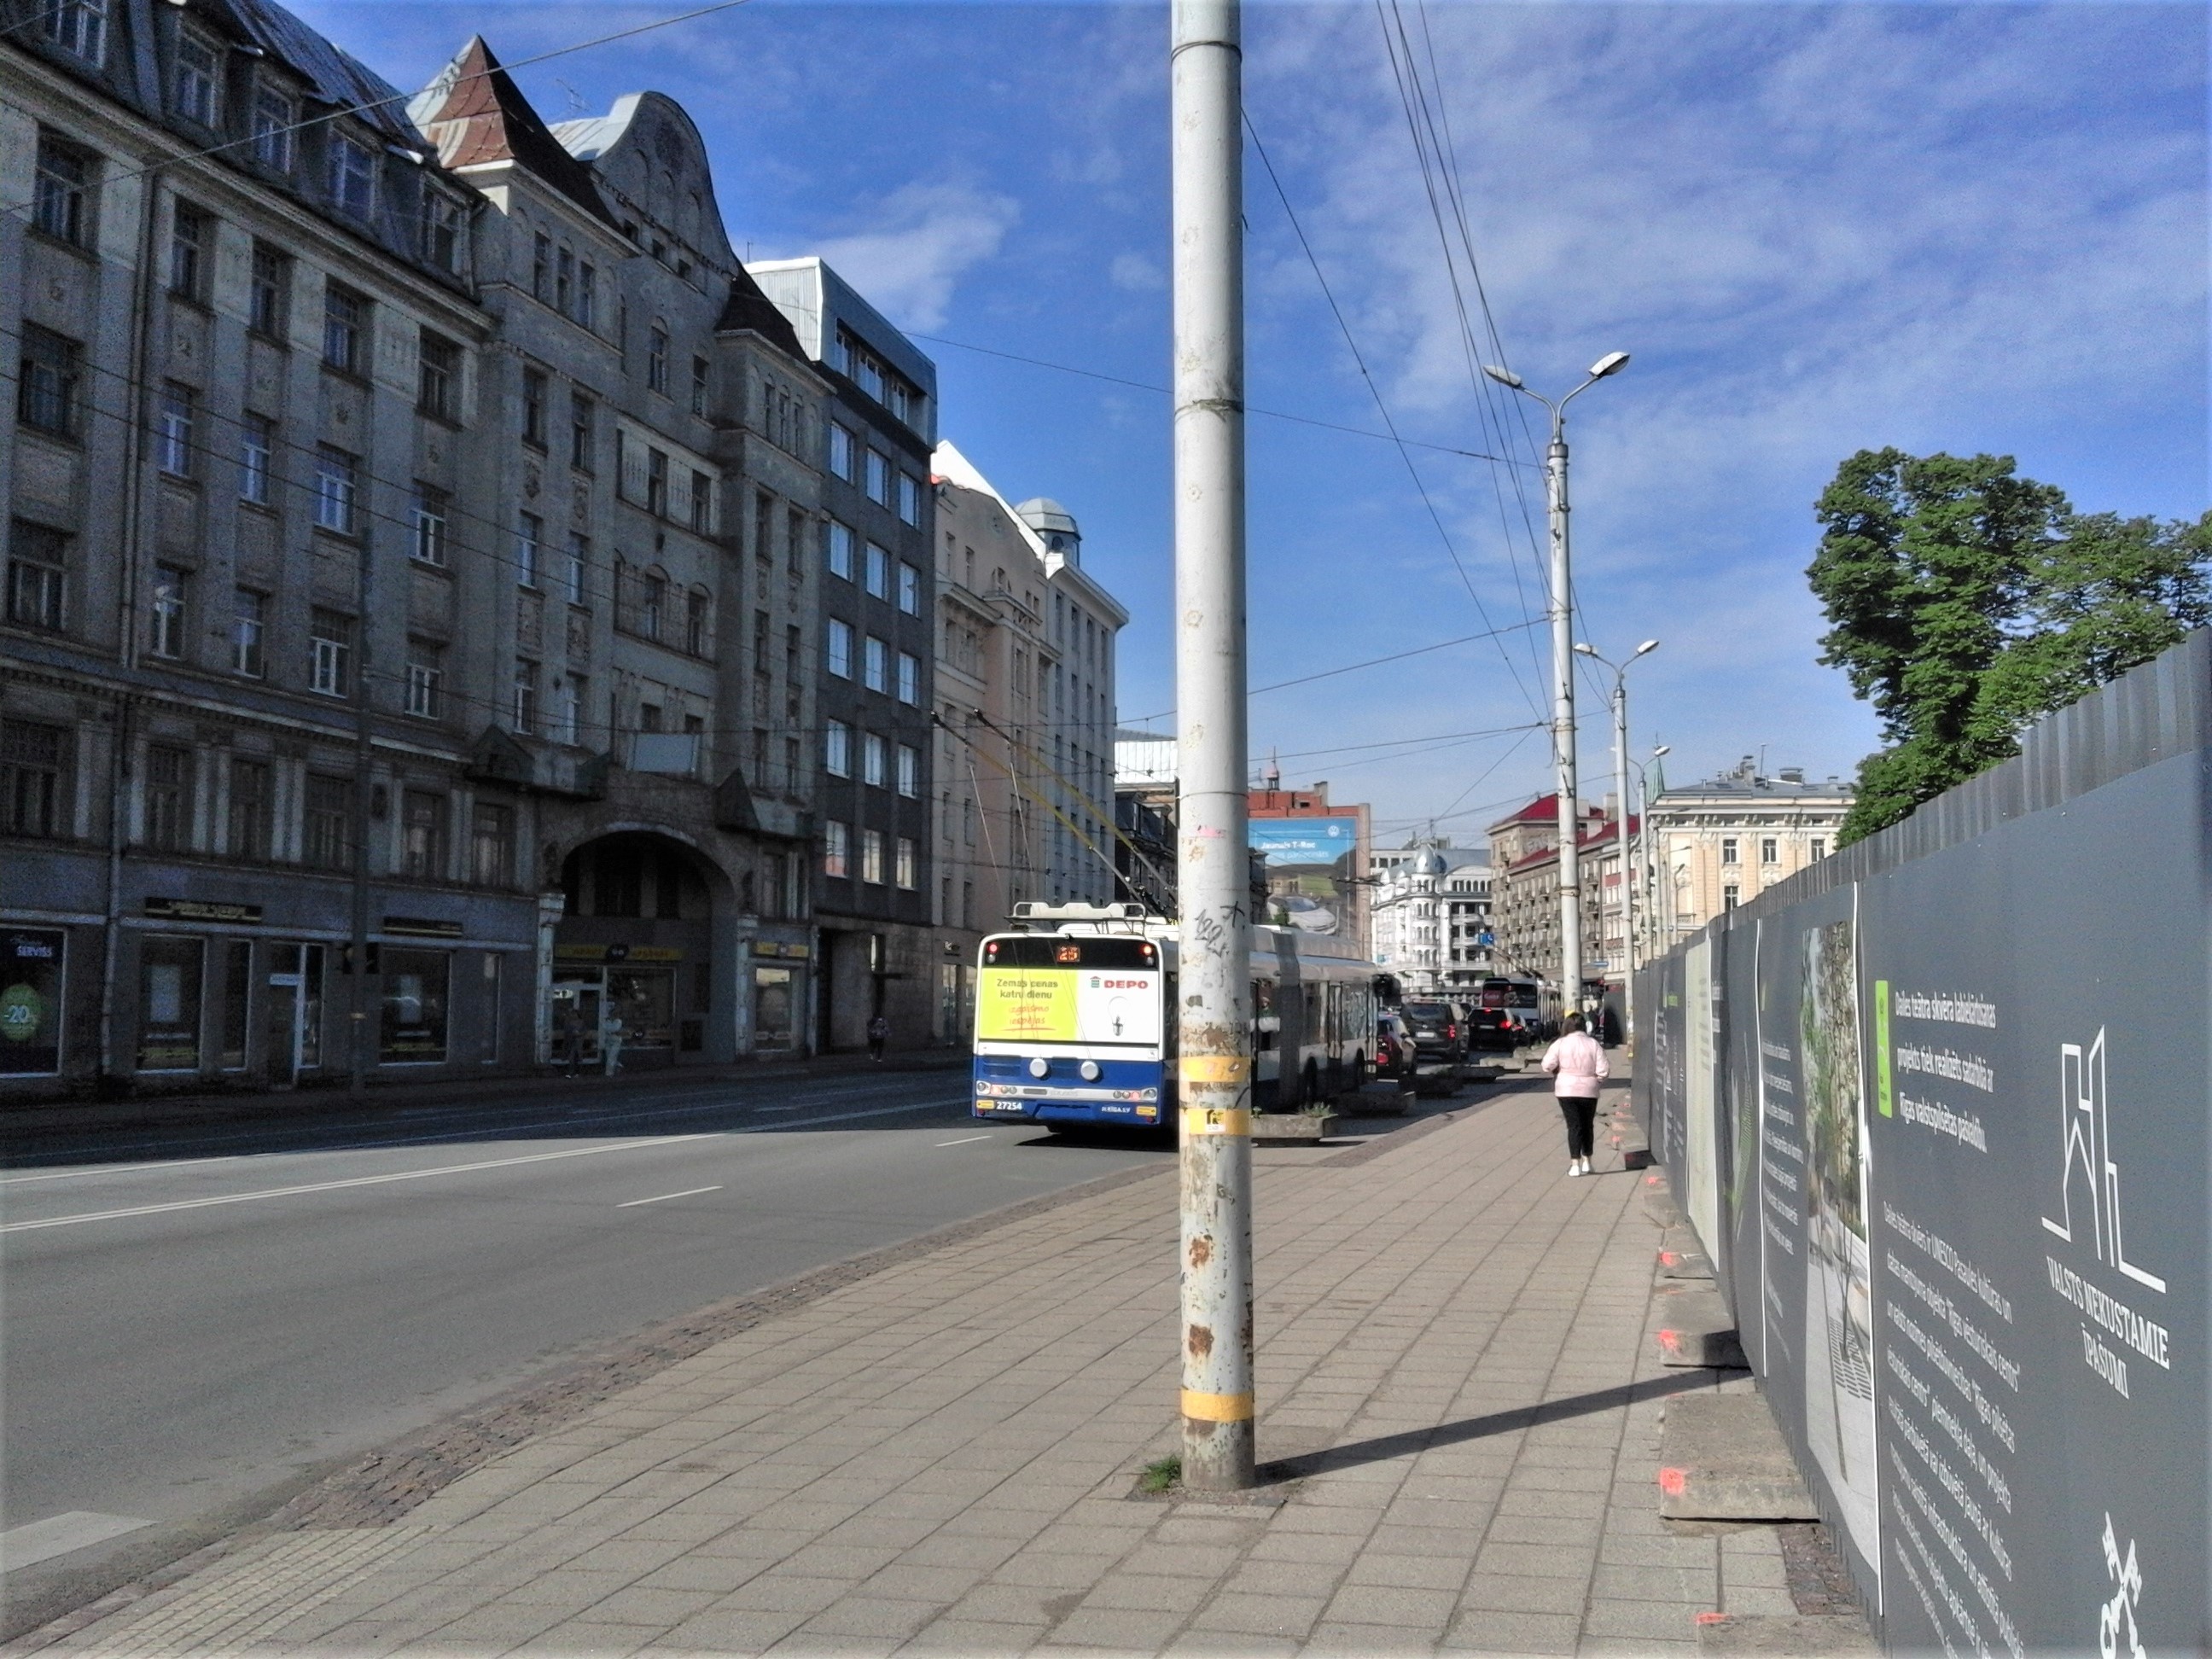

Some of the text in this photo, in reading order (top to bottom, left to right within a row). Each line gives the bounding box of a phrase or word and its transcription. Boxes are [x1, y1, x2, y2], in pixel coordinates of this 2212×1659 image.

[997, 979, 1027, 987] Zemas
[1104, 980, 1149, 989] DEPO
[1000, 989, 1052, 998] katru dienu
[996, 1101, 1023, 1110] 27254
[2046, 1255, 2170, 1370] VALSTS NEKUSTAMIE
[2081, 1322, 2129, 1400] ĪPAŠUMI
